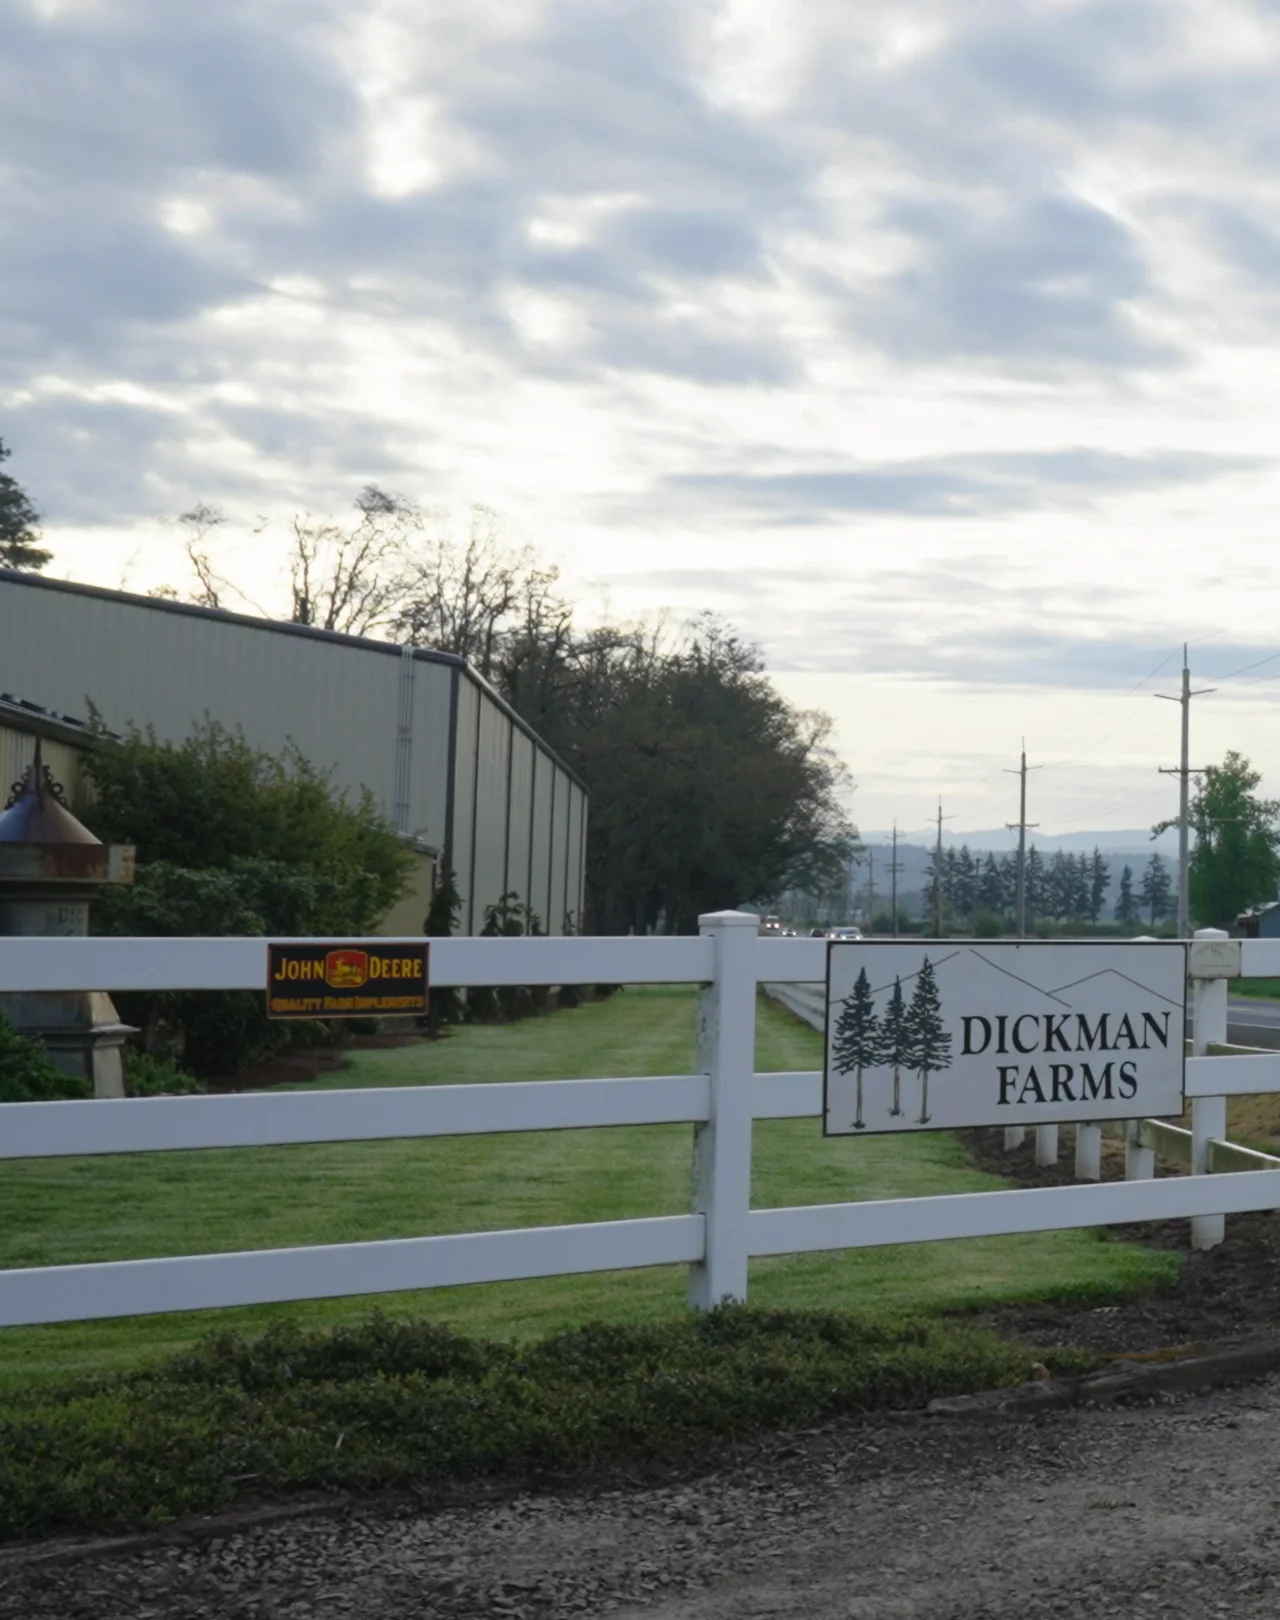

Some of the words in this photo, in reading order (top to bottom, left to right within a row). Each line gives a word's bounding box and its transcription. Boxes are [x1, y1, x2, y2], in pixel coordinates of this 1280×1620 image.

[274, 957, 325, 981] JOHN
[369, 956, 422, 979] DEERE
[960, 1011, 1171, 1055] DICKMAN
[996, 1060, 1138, 1105] FARMS
